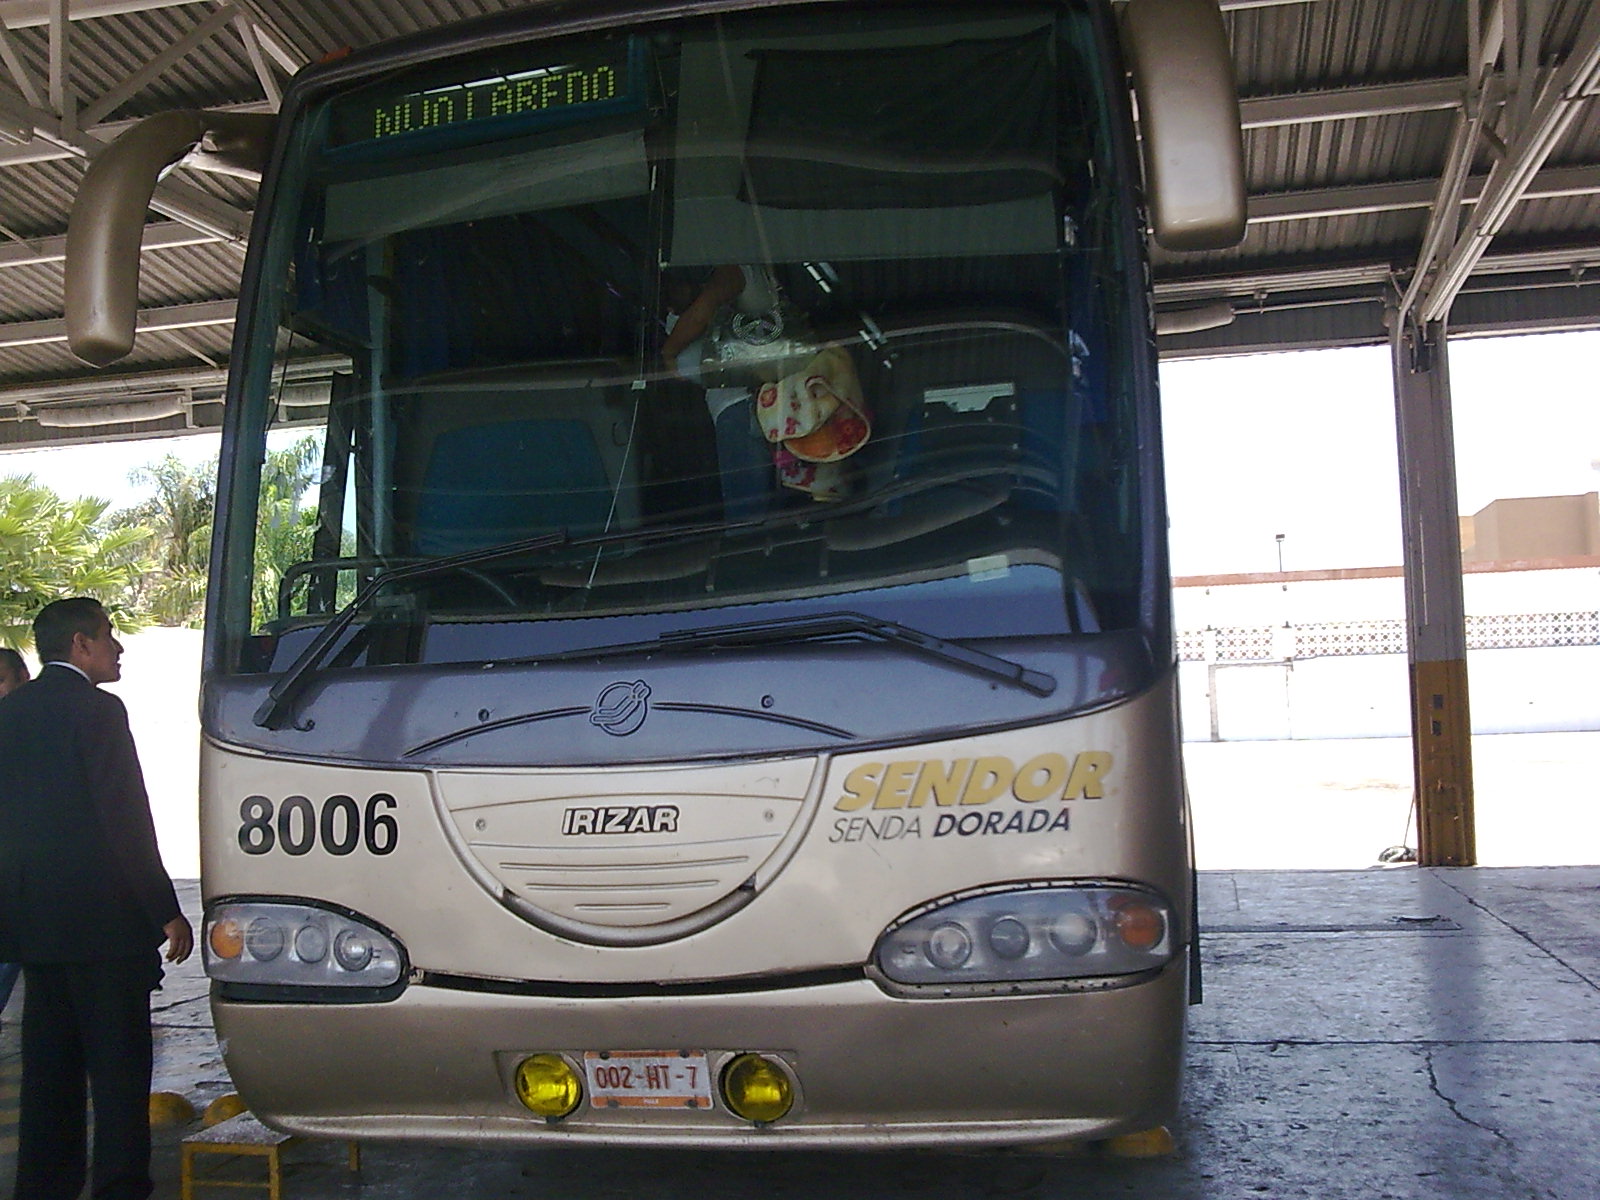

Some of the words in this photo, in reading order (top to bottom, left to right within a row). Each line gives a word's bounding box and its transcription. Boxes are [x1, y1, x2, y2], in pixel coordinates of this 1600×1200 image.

[833, 751, 1114, 812] SENDOR
[238, 793, 398, 856] 8006
[562, 805, 680, 835] IRIZAR
[828, 815, 922, 843] SENDA
[933, 807, 1071, 838] DORADA
